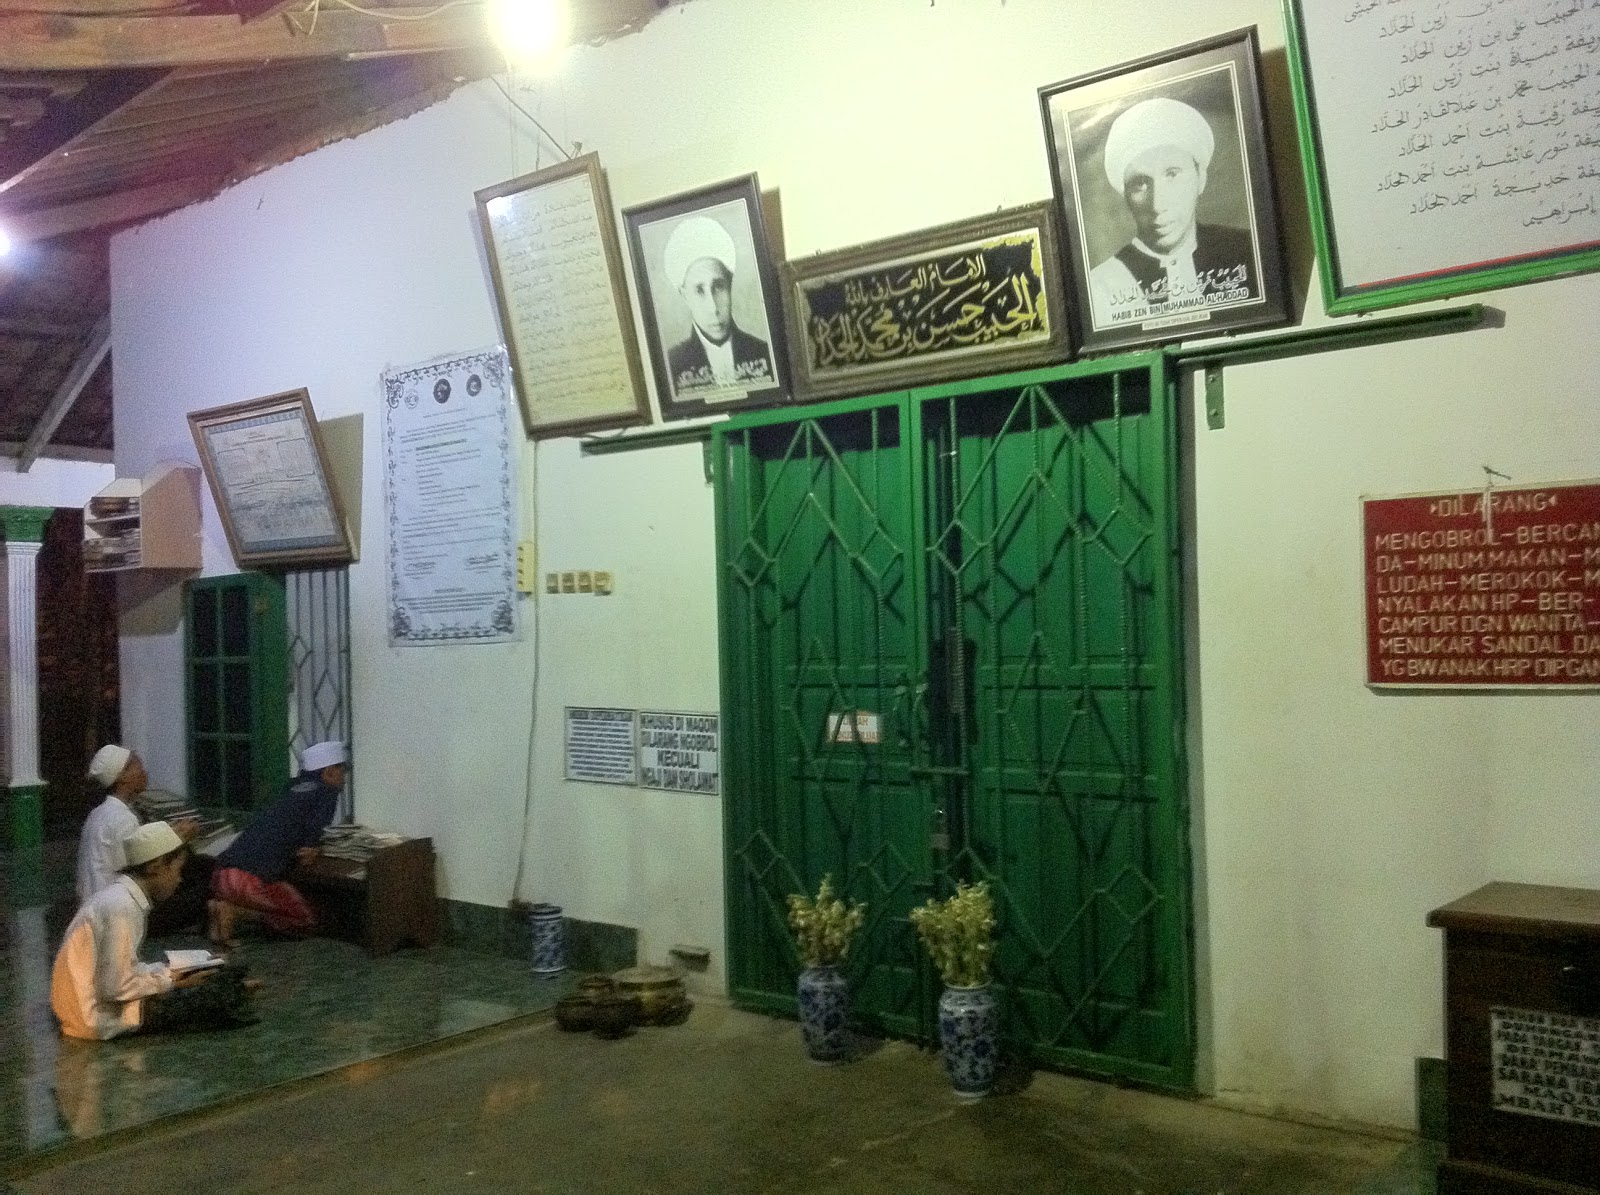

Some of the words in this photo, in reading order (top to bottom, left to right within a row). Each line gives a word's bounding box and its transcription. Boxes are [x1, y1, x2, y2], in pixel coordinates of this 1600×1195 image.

[1112, 310, 1132, 321] HABIB
[1134, 307, 1147, 318] ZEN
[1149, 304, 1161, 315] BIN
[1163, 296, 1205, 312] MUHAMMAD
[1438, 493, 1548, 516] DILARANG
[1378, 594, 1487, 614] NYALAKAN
[1378, 615, 1458, 634] CAMPUR
[1460, 614, 1503, 633] DGN
[1379, 636, 1475, 655] MENUKAR
[1481, 635, 1566, 654] SANDAL
[676, 717, 684, 731] DI
[641, 731, 679, 750] DILARANG
[680, 734, 718, 753] NGOBROL
[657, 750, 700, 769] KECUALI
